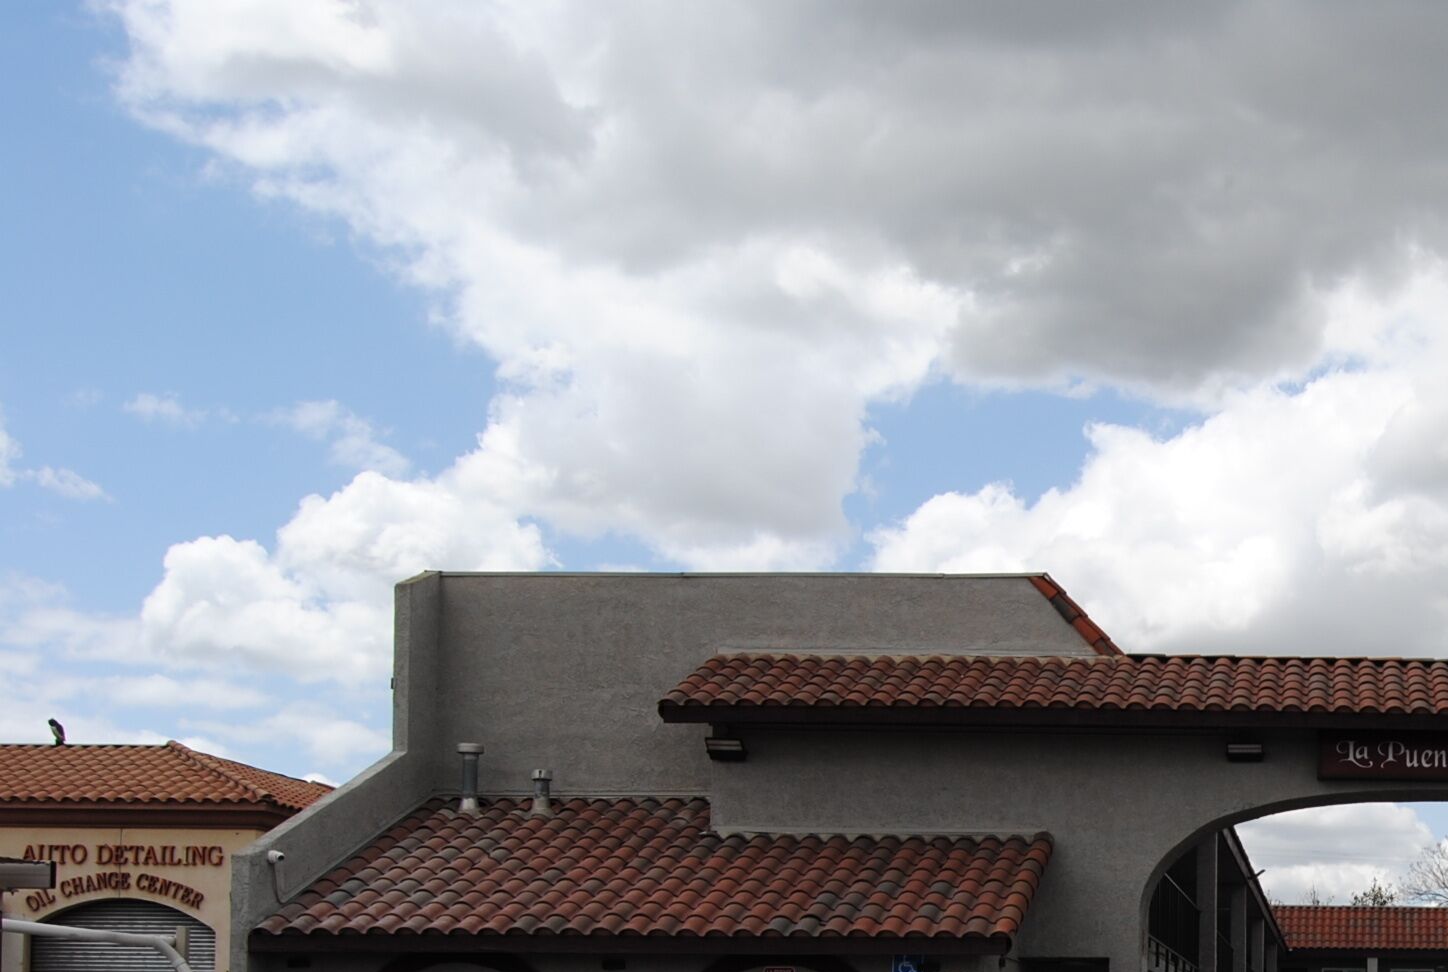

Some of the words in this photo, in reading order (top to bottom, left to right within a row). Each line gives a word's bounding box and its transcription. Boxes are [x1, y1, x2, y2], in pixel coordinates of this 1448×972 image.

[1336, 740, 1374, 768] La
[23, 844, 88, 866] AUTO
[95, 844, 225, 867] DETAILING
[26, 888, 56, 912] OIL
[60, 871, 131, 898] CHANGE
[136, 873, 205, 910] CENTER
